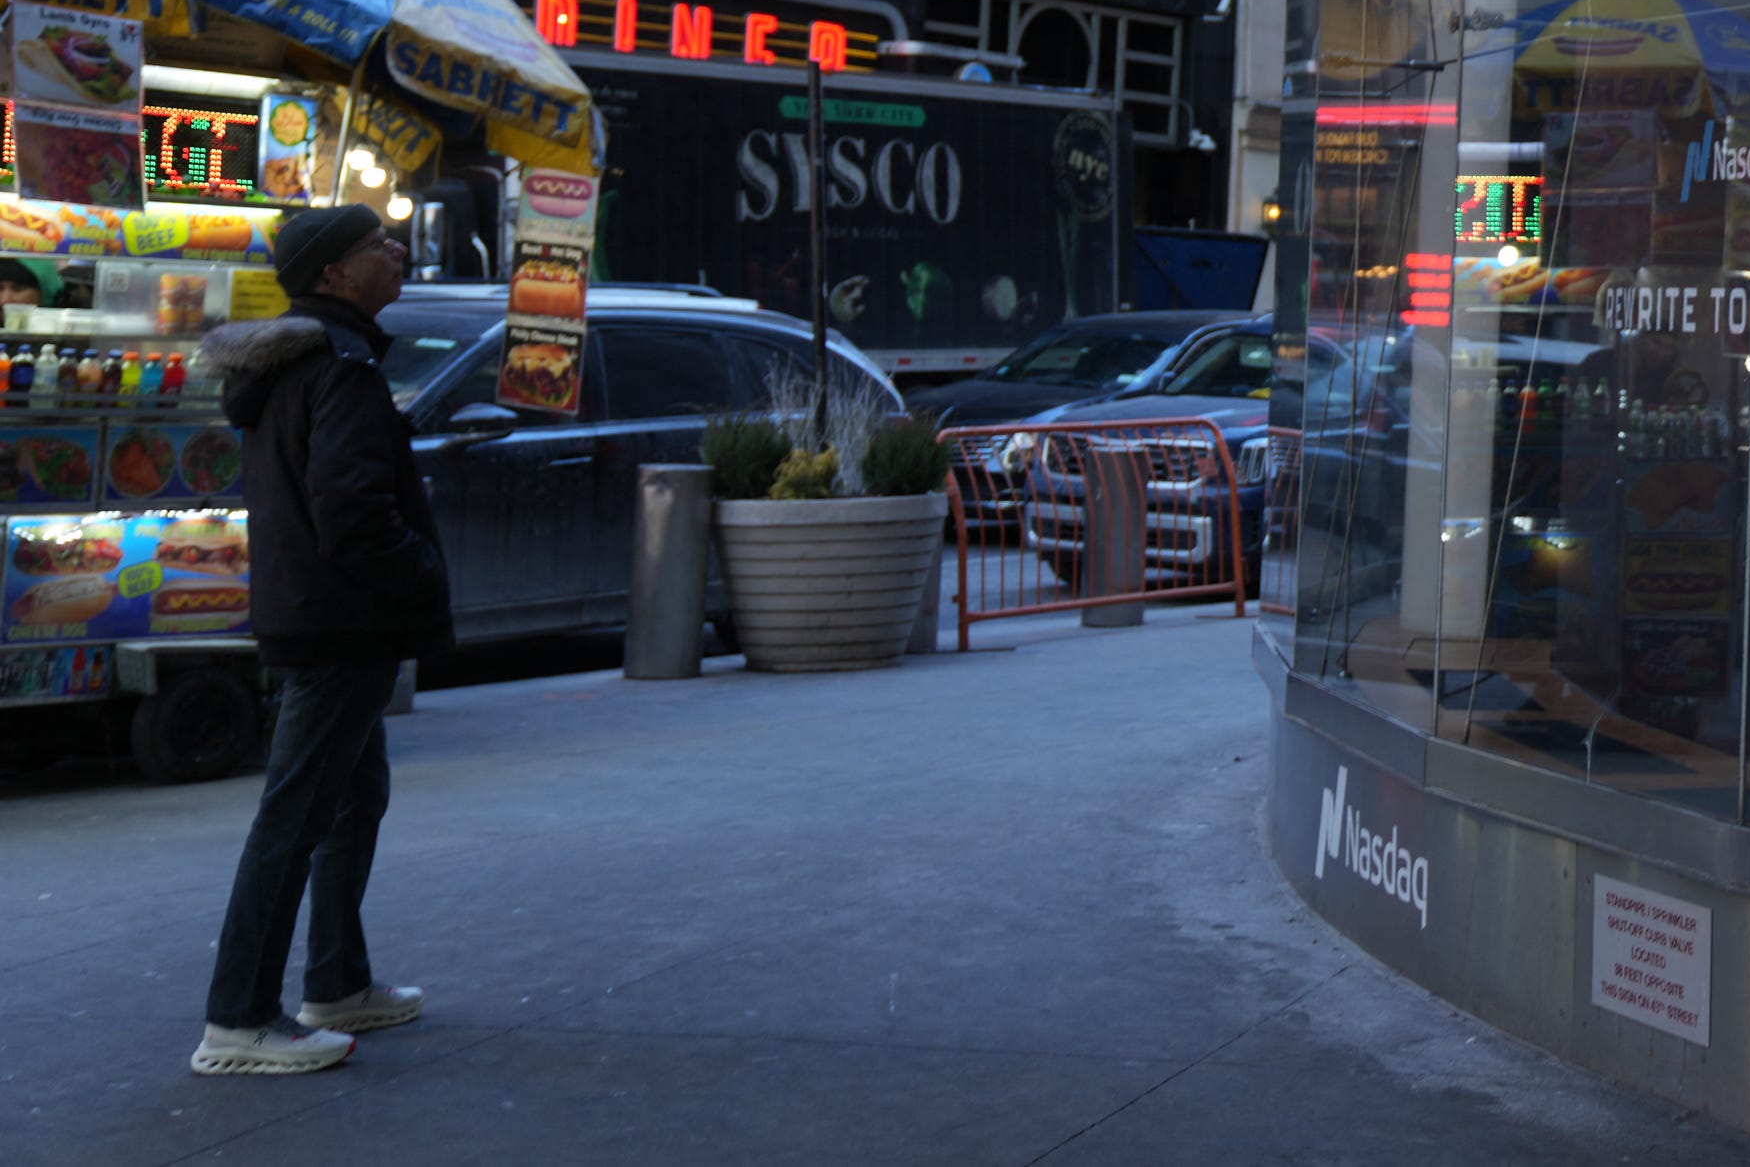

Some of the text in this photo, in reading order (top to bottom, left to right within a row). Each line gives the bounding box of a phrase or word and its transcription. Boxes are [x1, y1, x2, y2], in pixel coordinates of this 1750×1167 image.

[394, 40, 579, 134] SABRETT
[736, 128, 962, 226] SYSCO
[136, 228, 176, 250] BEEF
[1605, 286, 1697, 335] REWRITE
[1344, 804, 1429, 930] Nasdaq
[1651, 905, 1697, 933] SPRINKLER
[1631, 945, 1666, 970] LOCATED
[1669, 936, 1694, 956] VALVE
[1601, 979, 1617, 999] THIS
[1618, 986, 1637, 1006] SIGN
[1637, 993, 1650, 1010] ON
[1667, 1004, 1699, 1027] STREET
[1624, 965, 1643, 983] FEET
[1644, 973, 1685, 1000] OPPOSITE
